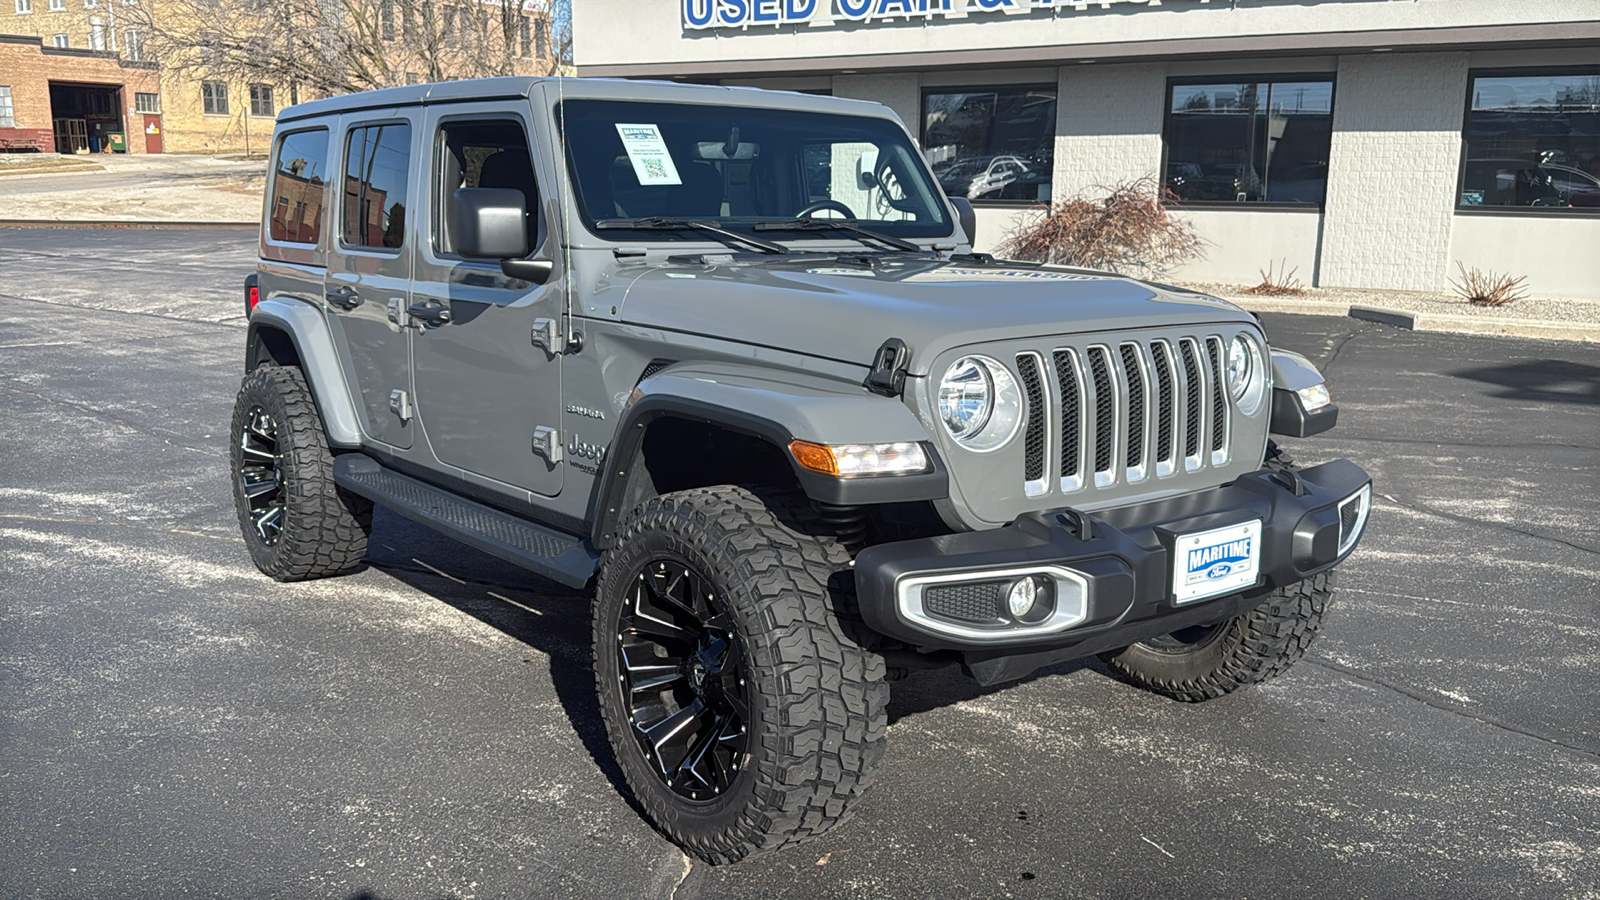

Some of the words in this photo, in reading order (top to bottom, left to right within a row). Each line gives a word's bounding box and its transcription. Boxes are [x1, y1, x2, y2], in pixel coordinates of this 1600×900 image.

[684, 0, 818, 29] USED
[837, 0, 956, 20] CA
[568, 433, 606, 466] Jeep
[1188, 539, 1250, 572] MARITIME
